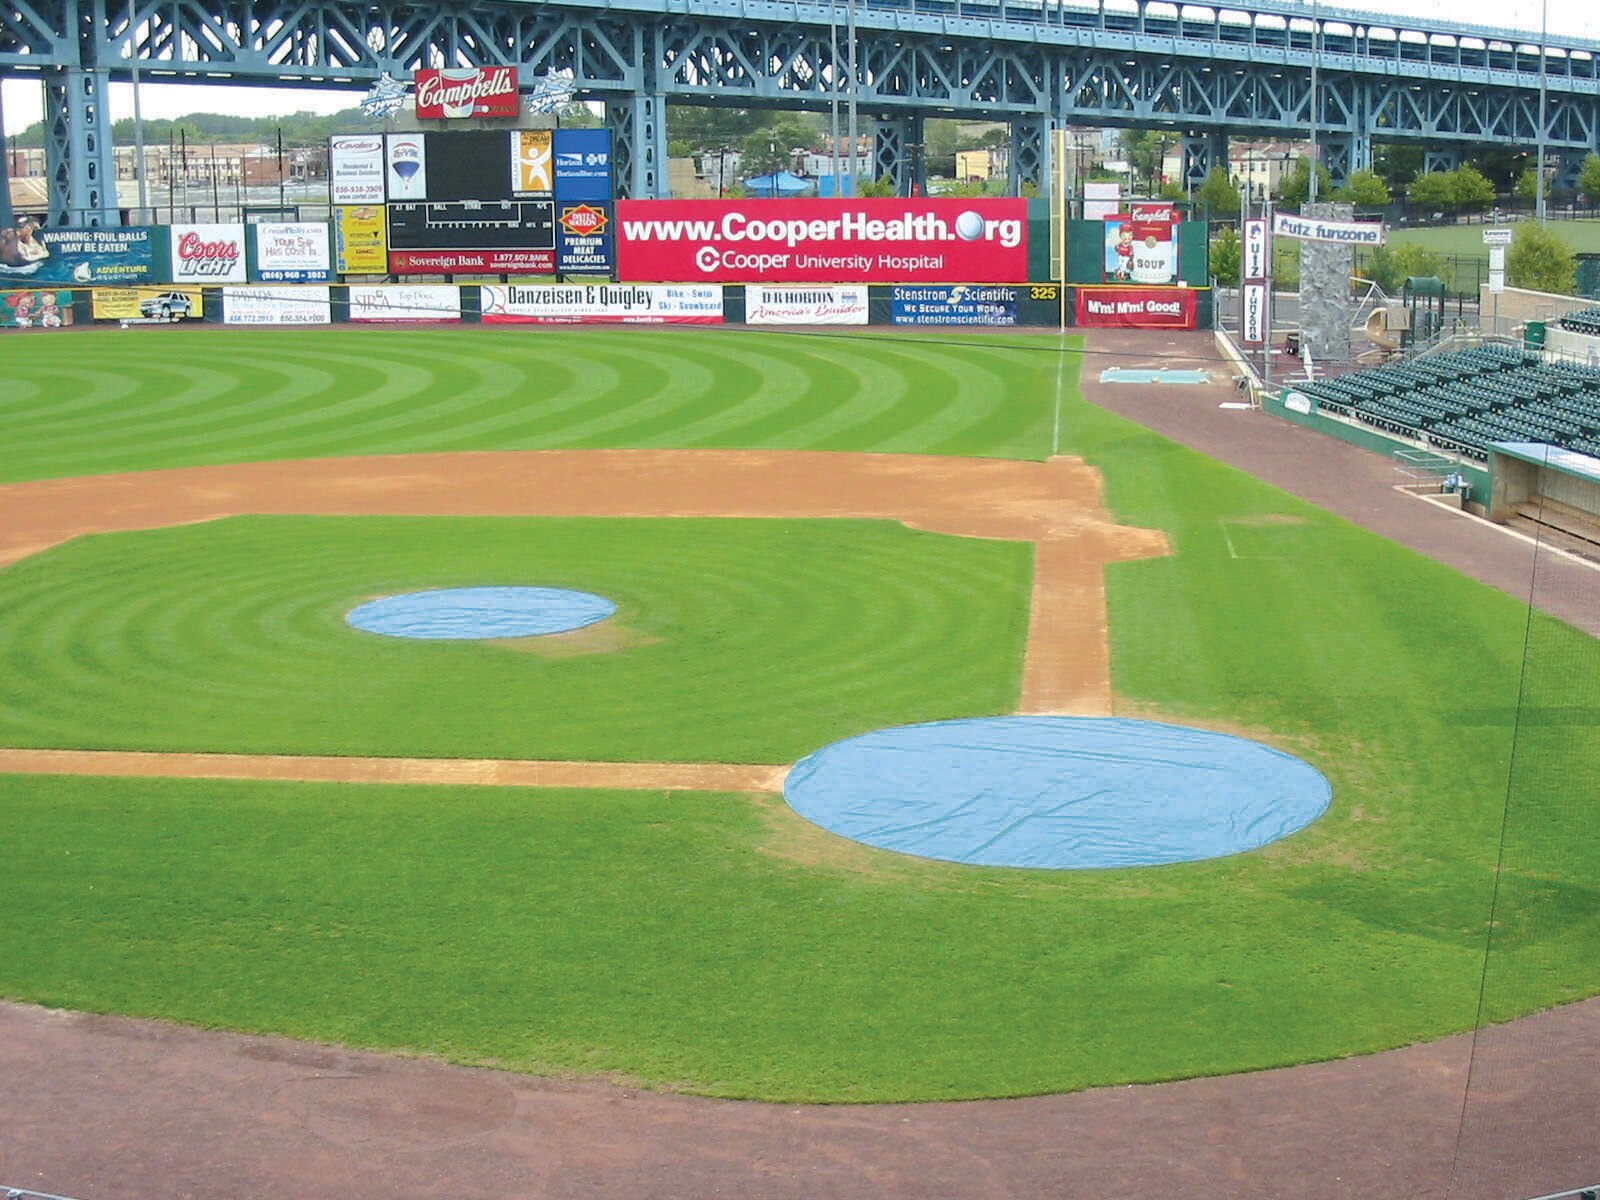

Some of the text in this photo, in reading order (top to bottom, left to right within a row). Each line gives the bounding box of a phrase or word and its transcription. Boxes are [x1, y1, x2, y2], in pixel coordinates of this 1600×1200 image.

[418, 68, 515, 108] Campbell's
[1132, 208, 1170, 224] Campbell's
[44, 231, 148, 242] WARNING: FOUL BALLS
[1316, 225, 1377, 242] funzone
[61, 243, 81, 254] MAY
[84, 242, 97, 252] BE
[178, 232, 239, 260] Coors
[564, 238, 603, 246] PREMIUM
[574, 246, 595, 254] MEAT
[408, 256, 484, 268] Sovereign Bank
[562, 254, 606, 264] DELICACIES
[722, 251, 944, 272] Cooper University Hospital
[1137, 259, 1166, 270] SOUP
[96, 265, 148, 274] ADVENTURE
[178, 257, 237, 276] LIGHT
[508, 286, 653, 310] Danzeisen & Quigley
[894, 288, 1016, 302] Stenstrom Scientific
[1030, 287, 1057, 300] 325
[1088, 300, 1180, 314] M'm! M'm! Good!
